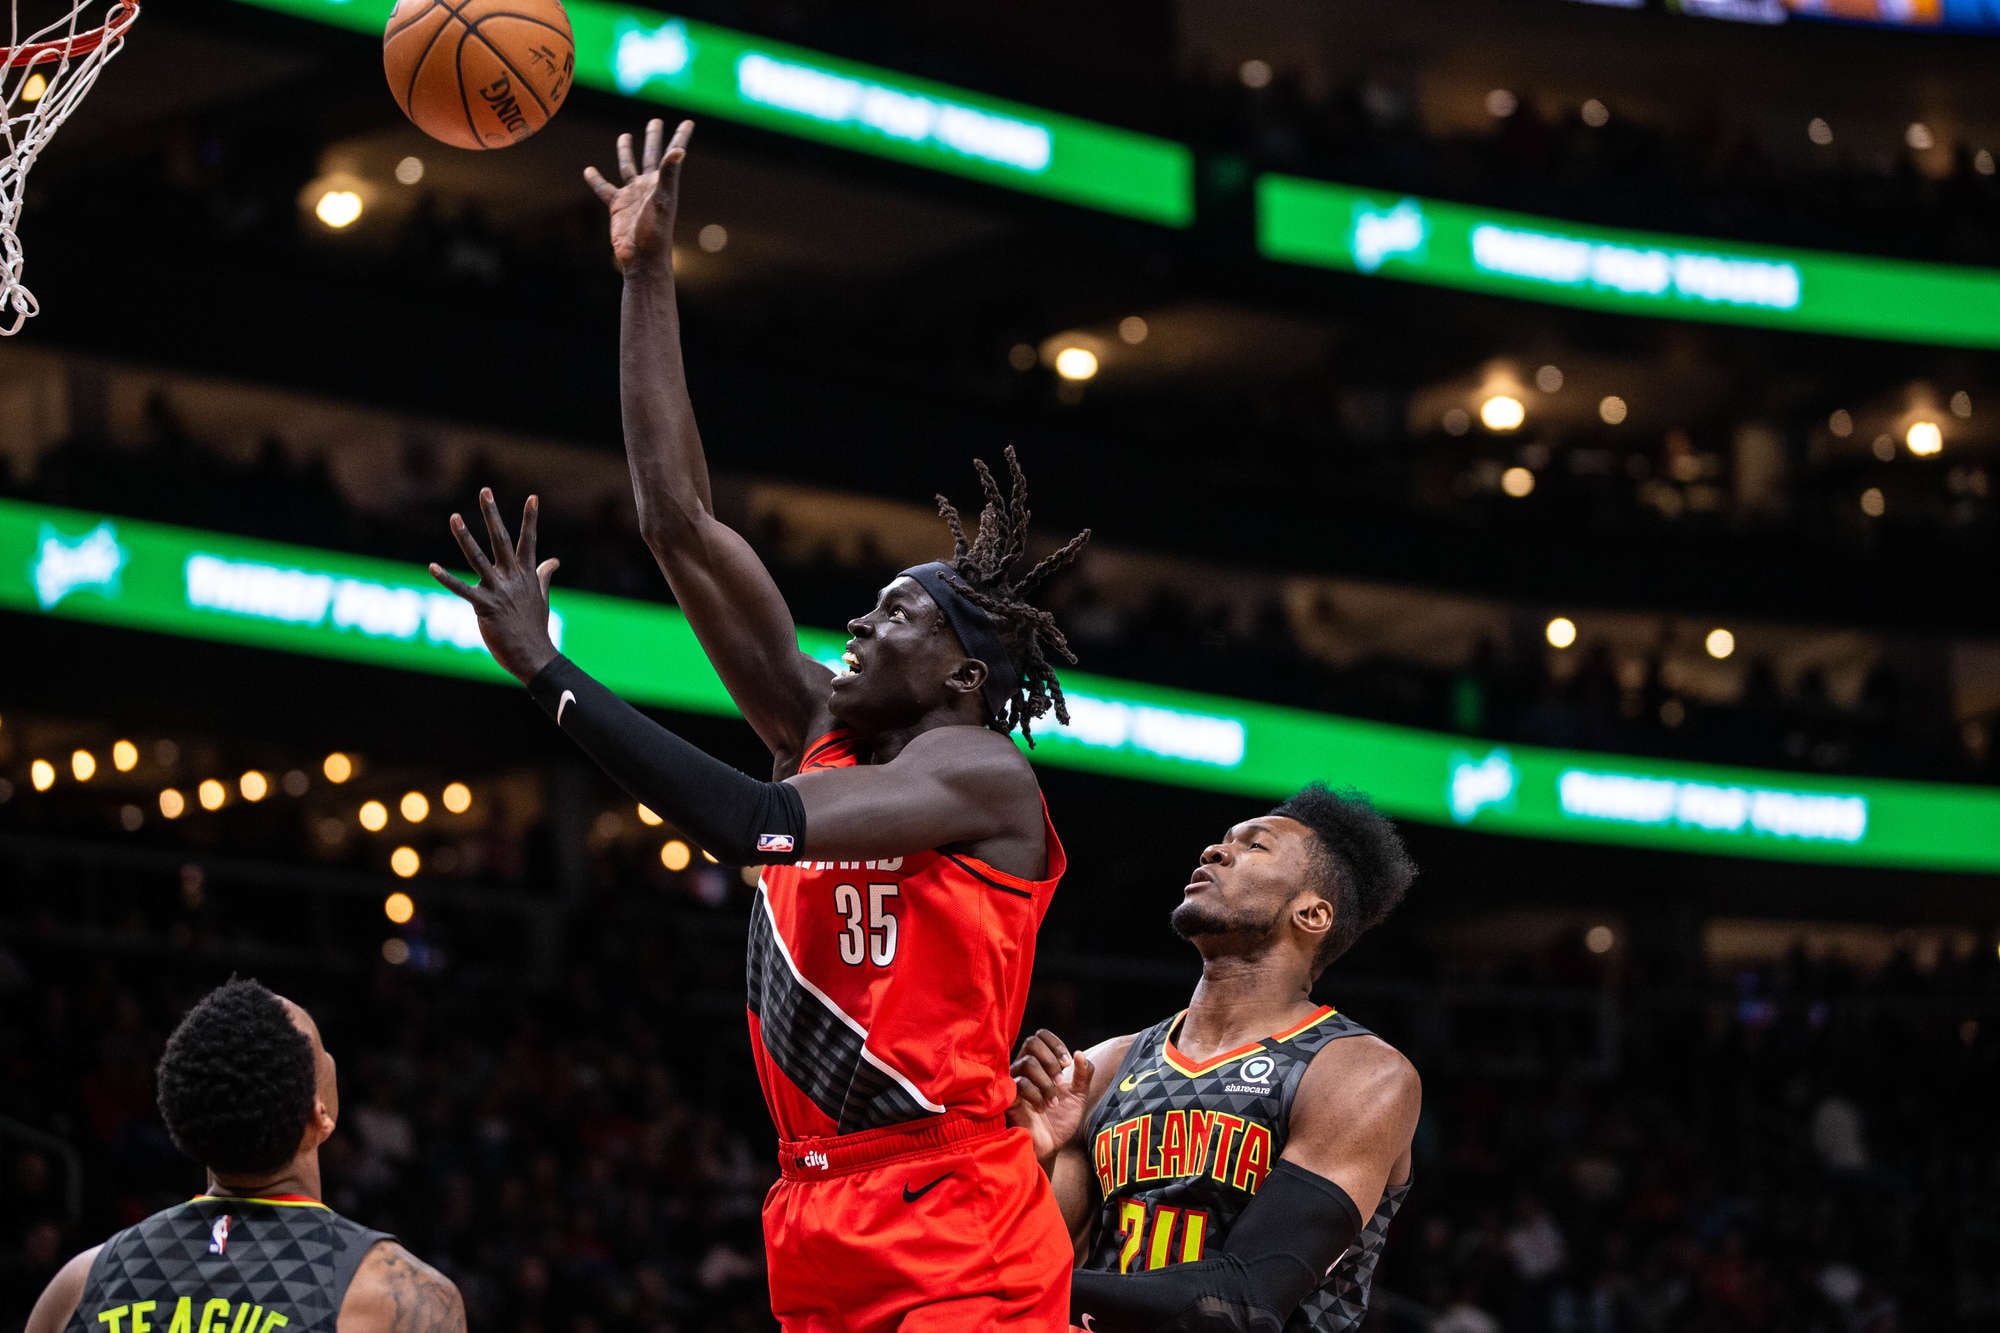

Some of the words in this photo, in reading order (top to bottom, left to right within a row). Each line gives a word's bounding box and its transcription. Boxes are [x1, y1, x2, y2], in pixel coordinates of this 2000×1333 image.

[834, 883, 899, 968] 35
[1224, 1083, 1271, 1095] sharecare
[804, 1150, 829, 1170] city
[1095, 1109, 1272, 1201] ATLANTA
